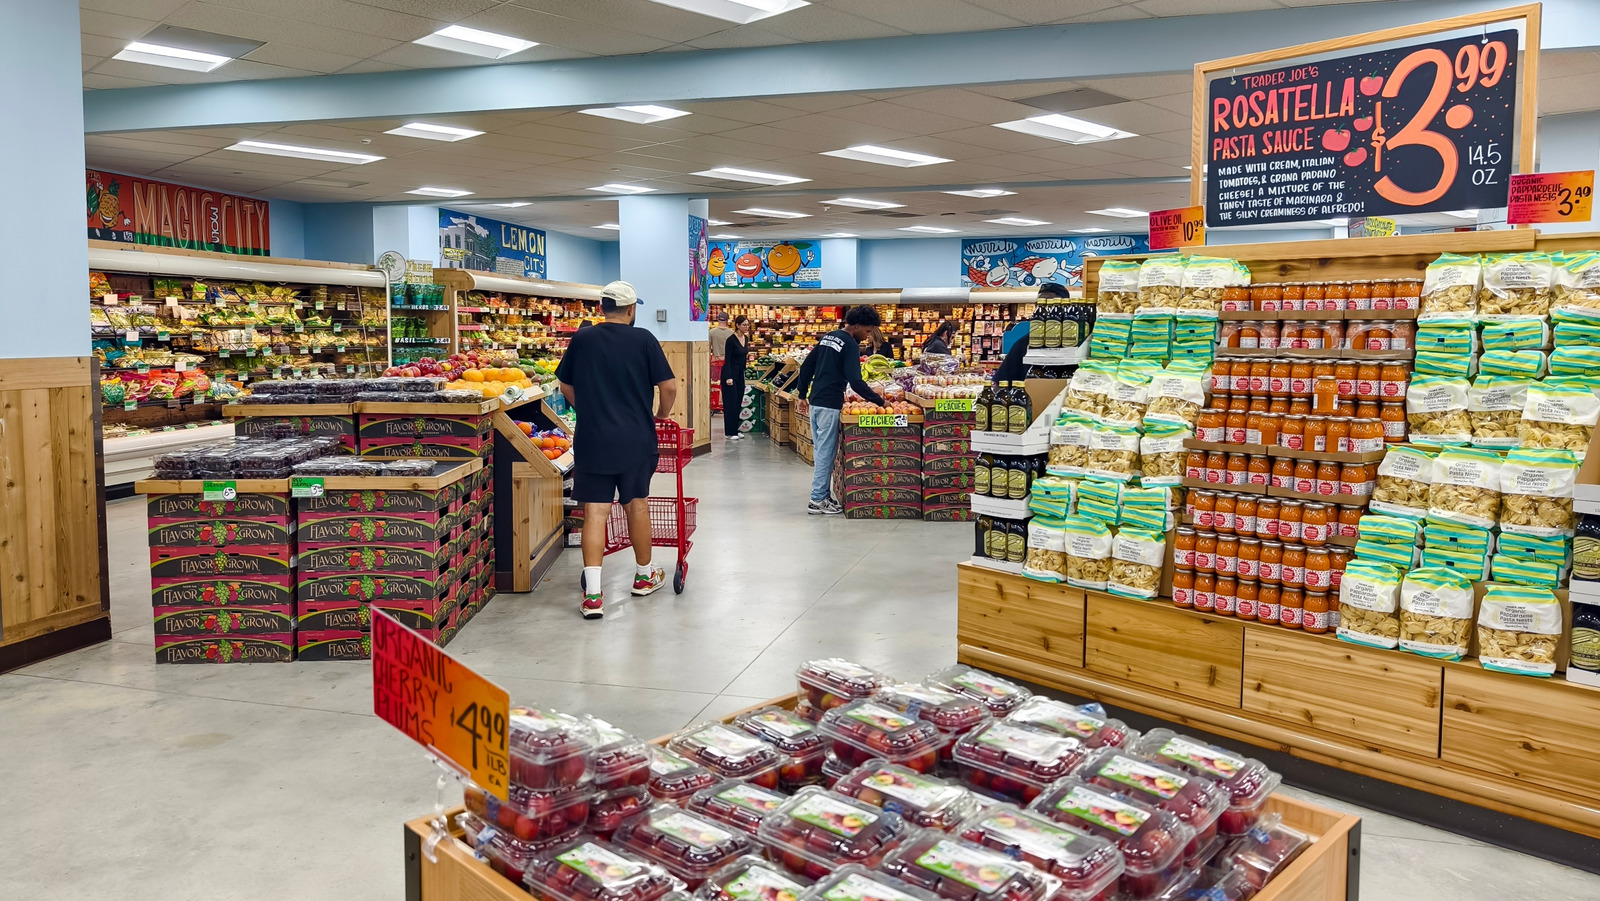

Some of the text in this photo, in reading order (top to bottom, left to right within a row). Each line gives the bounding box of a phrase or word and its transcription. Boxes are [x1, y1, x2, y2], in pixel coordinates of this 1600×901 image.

[1242, 66, 1319, 90] TRADER JOE'S
[1214, 77, 1355, 133] ROSATELLA
[1213, 126, 1315, 161] PASTA SAUCE
[1468, 143, 1502, 166] 14.5
[1218, 156, 1334, 176] MADE WITH CREAM, ITALIAN
[1270, 172, 1298, 184] GRANA
[1301, 168, 1336, 180] PADANO
[1472, 168, 1498, 186] OZ
[1512, 177, 1544, 186] ORGANIC
[1218, 180, 1346, 200] CHEESE! A MIXTURE OF THE
[1218, 192, 1343, 210] TANGY TASTE OF MARINARA &
[1510, 192, 1557, 204] PASTA NESTS
[134, 182, 267, 256] MAGIC CITY
[1219, 202, 1365, 221] THE SILKY CREAMINESS OF ALFREDO!
[210, 206, 220, 244] 305
[1150, 214, 1182, 227] OLIVE OIL
[502, 224, 545, 256] LEMON
[965, 238, 1018, 264] merrily
[1026, 237, 1076, 258] merrily
[1084, 236, 1140, 254] merrily
[524, 256, 544, 274] CITY
[938, 402, 966, 411] PEACHES
[313, 422, 344, 432] GROWN
[386, 422, 453, 434] FLAVOR GROWN
[860, 416, 895, 426] PEACHES
[932, 428, 951, 436] FLAVOR
[384, 448, 450, 456] FLAVOR GROWN
[853, 443, 871, 451] FLAVOR
[932, 461, 951, 470] FLAVOR
[853, 476, 872, 484] FLAVOR
[929, 478, 949, 487] FLAVOR
[310, 495, 424, 510] FLAVOR GROWN
[853, 493, 872, 501] FLAVOR
[160, 499, 276, 514] FLAVOR GROWN
[854, 508, 872, 517] FLAVOR
[931, 512, 950, 520] FLAVOR
[160, 528, 276, 544] FLAVOR GROWN
[310, 525, 424, 540] FLAVOR GROWN
[181, 559, 260, 573] FLAVOR GROWN
[310, 554, 423, 568] FLAVOR GROWN
[163, 589, 278, 604] FLAVOR GROWN
[310, 583, 423, 597] FLAVOR GROWN
[166, 618, 280, 632] FLAVOR GROWN
[325, 613, 357, 627] FLAVOR
[167, 646, 280, 661] FLAVOR GROWN
[328, 644, 360, 657] FLAVOR
[374, 615, 453, 694] ORGANIC
[374, 652, 438, 717] CHERRY
[376, 688, 434, 746] PLUMS
